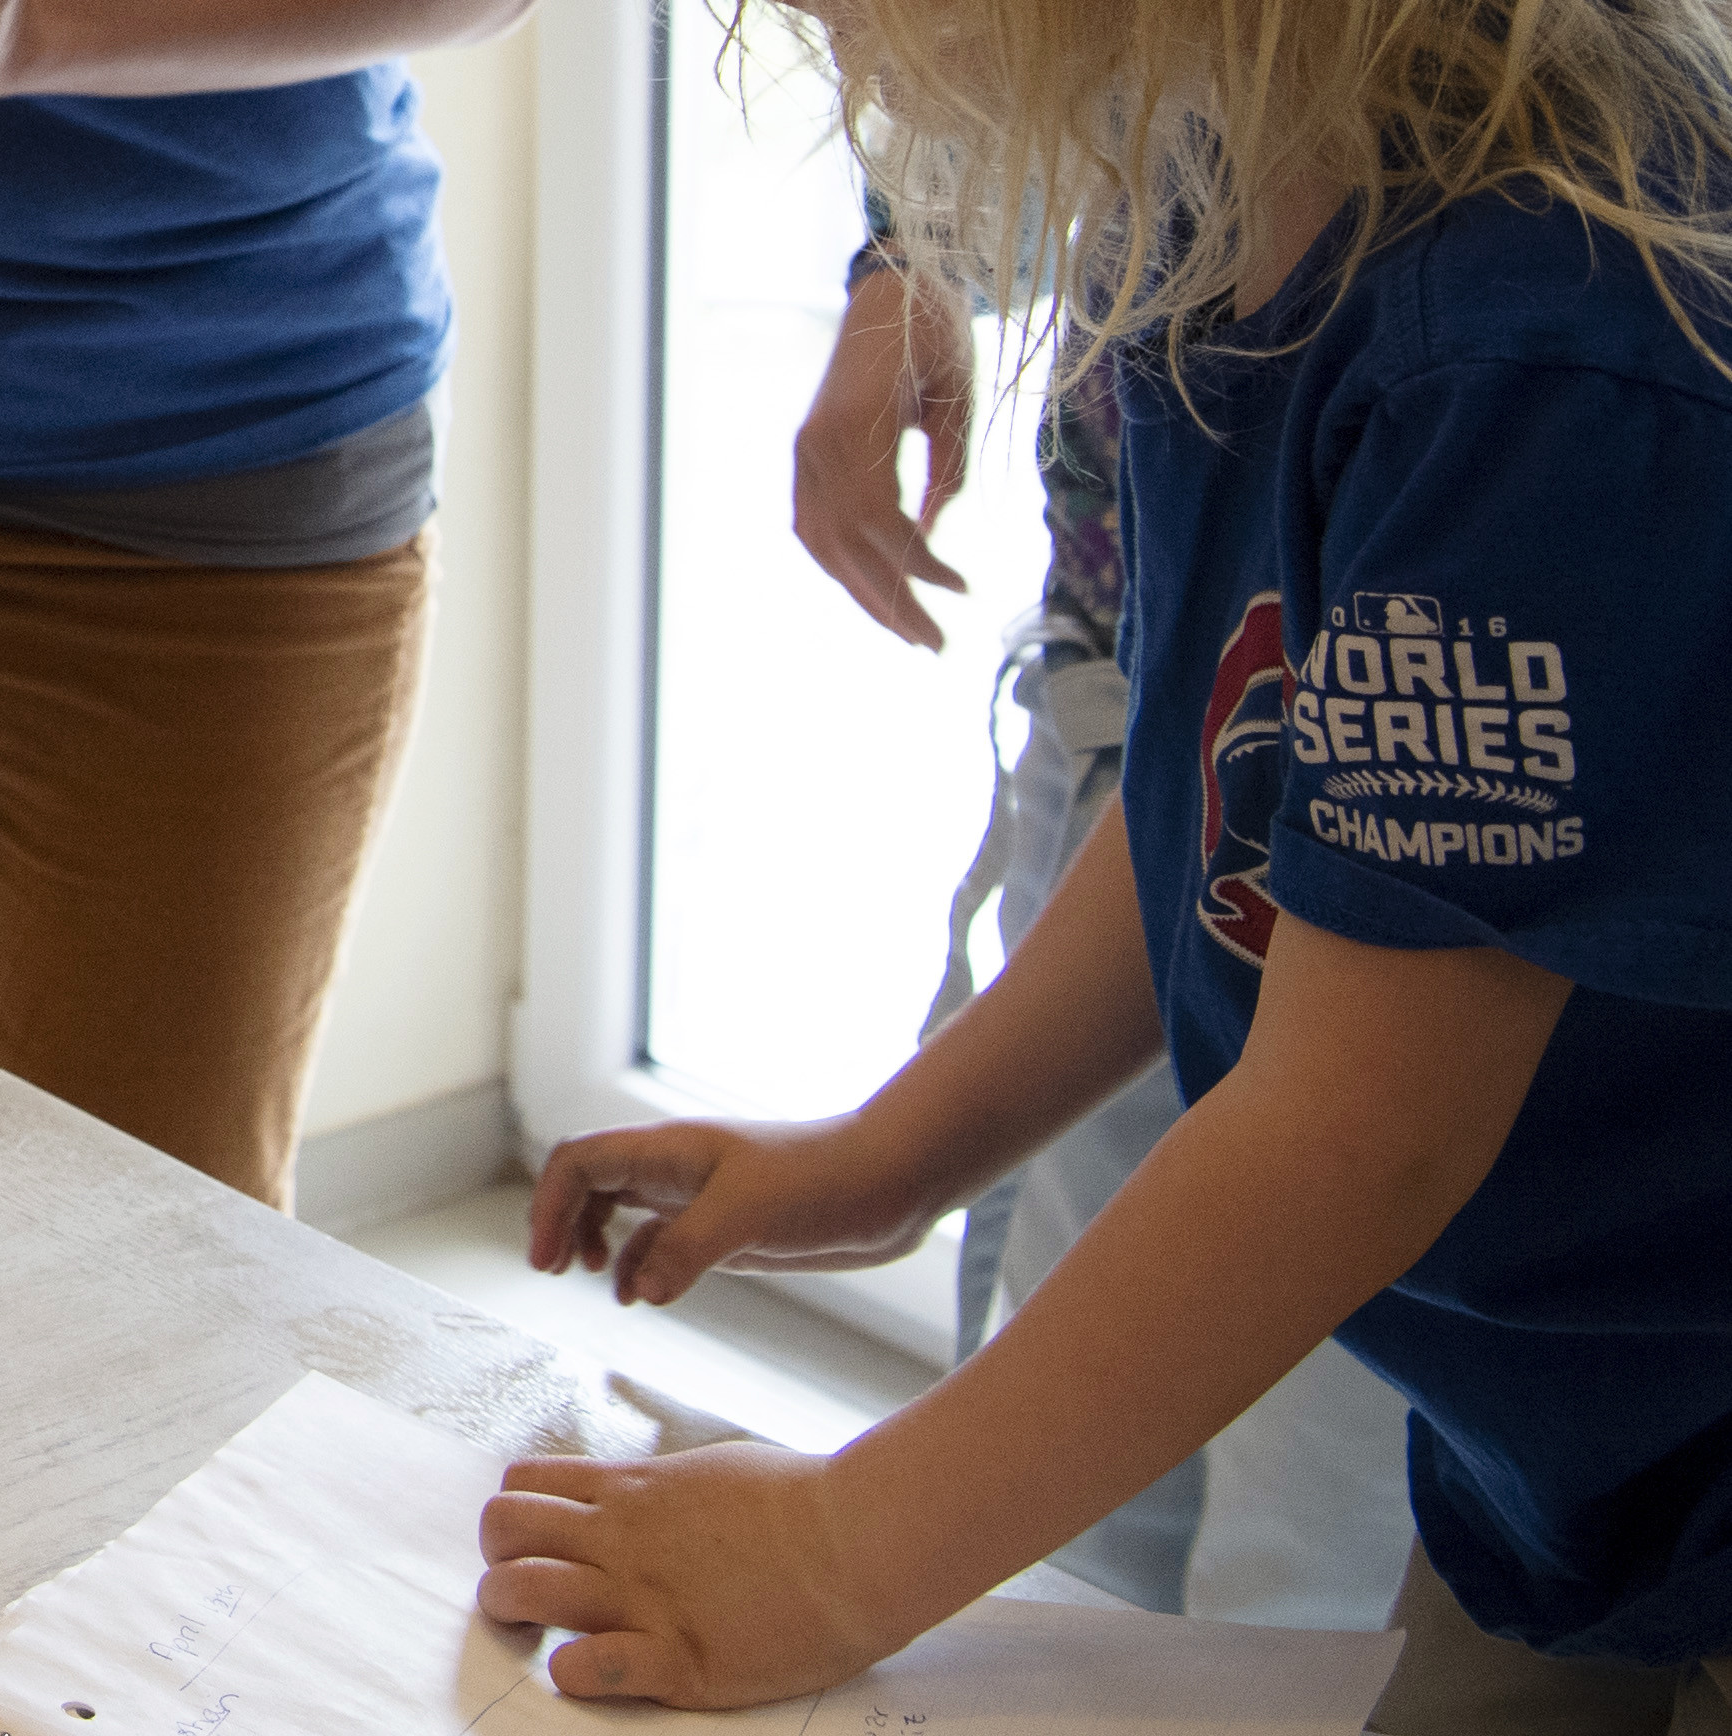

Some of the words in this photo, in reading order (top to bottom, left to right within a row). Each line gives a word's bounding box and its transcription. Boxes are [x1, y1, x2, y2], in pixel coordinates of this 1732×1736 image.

[1457, 616, 1508, 638] 16
[1293, 690, 1576, 783] SERIES
[1309, 798, 1585, 866] CHAMPIONS
